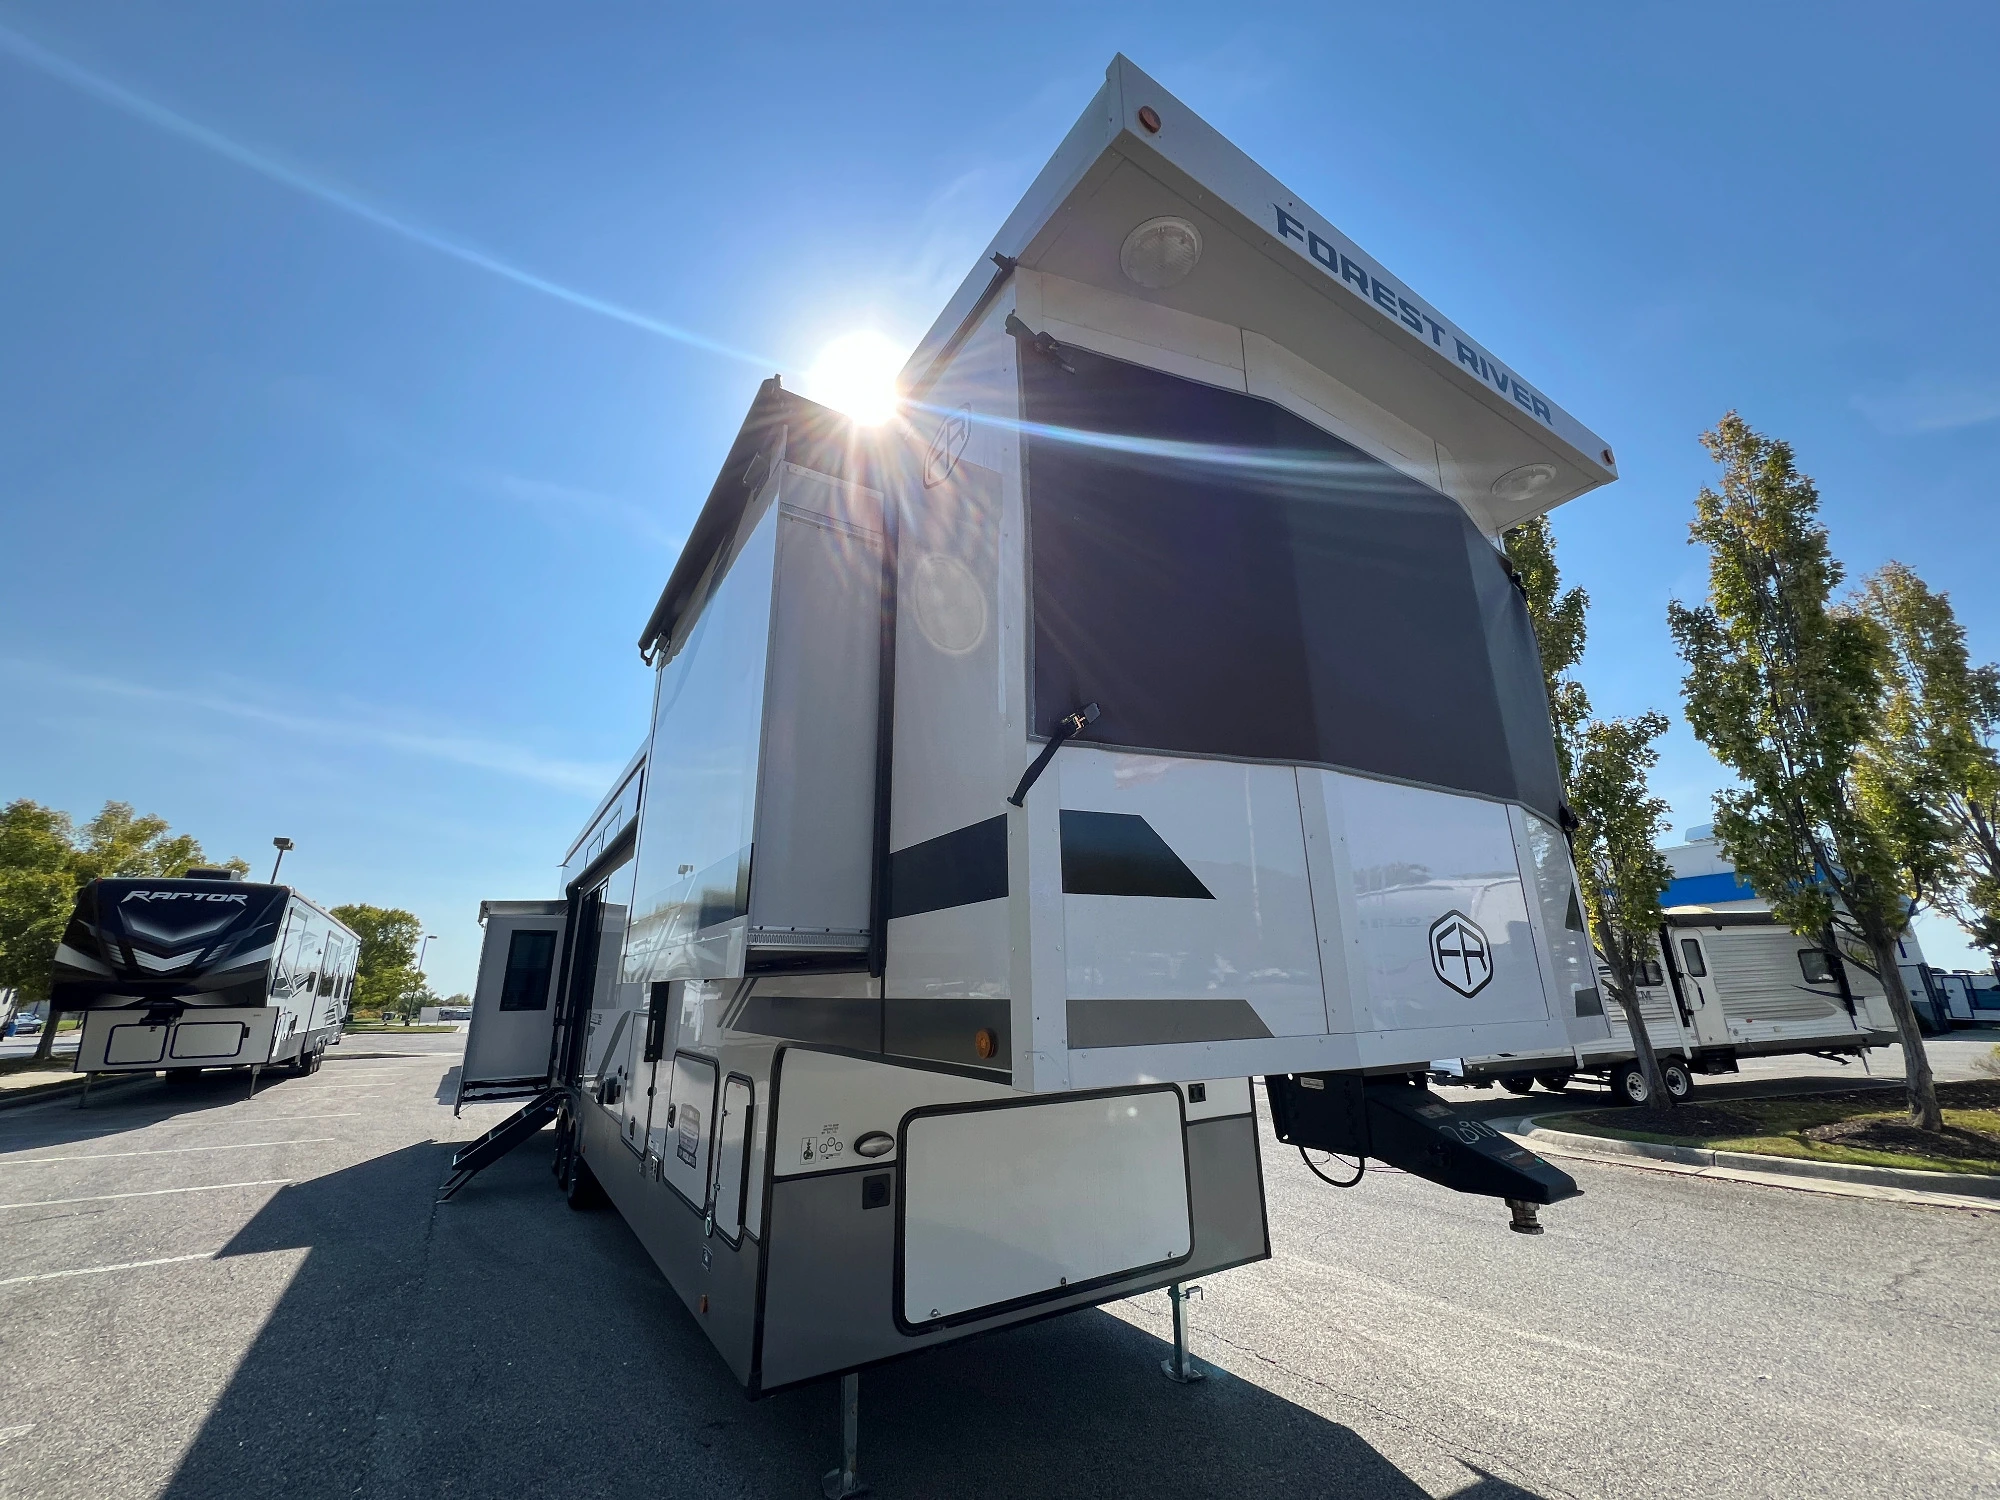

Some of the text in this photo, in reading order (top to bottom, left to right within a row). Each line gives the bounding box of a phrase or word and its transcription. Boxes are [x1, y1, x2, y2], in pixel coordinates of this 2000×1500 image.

[1273, 203, 1553, 426] FOREST RIVER
[121, 890, 248, 907] RAPTOR
[1438, 1120, 1498, 1145] 2098
